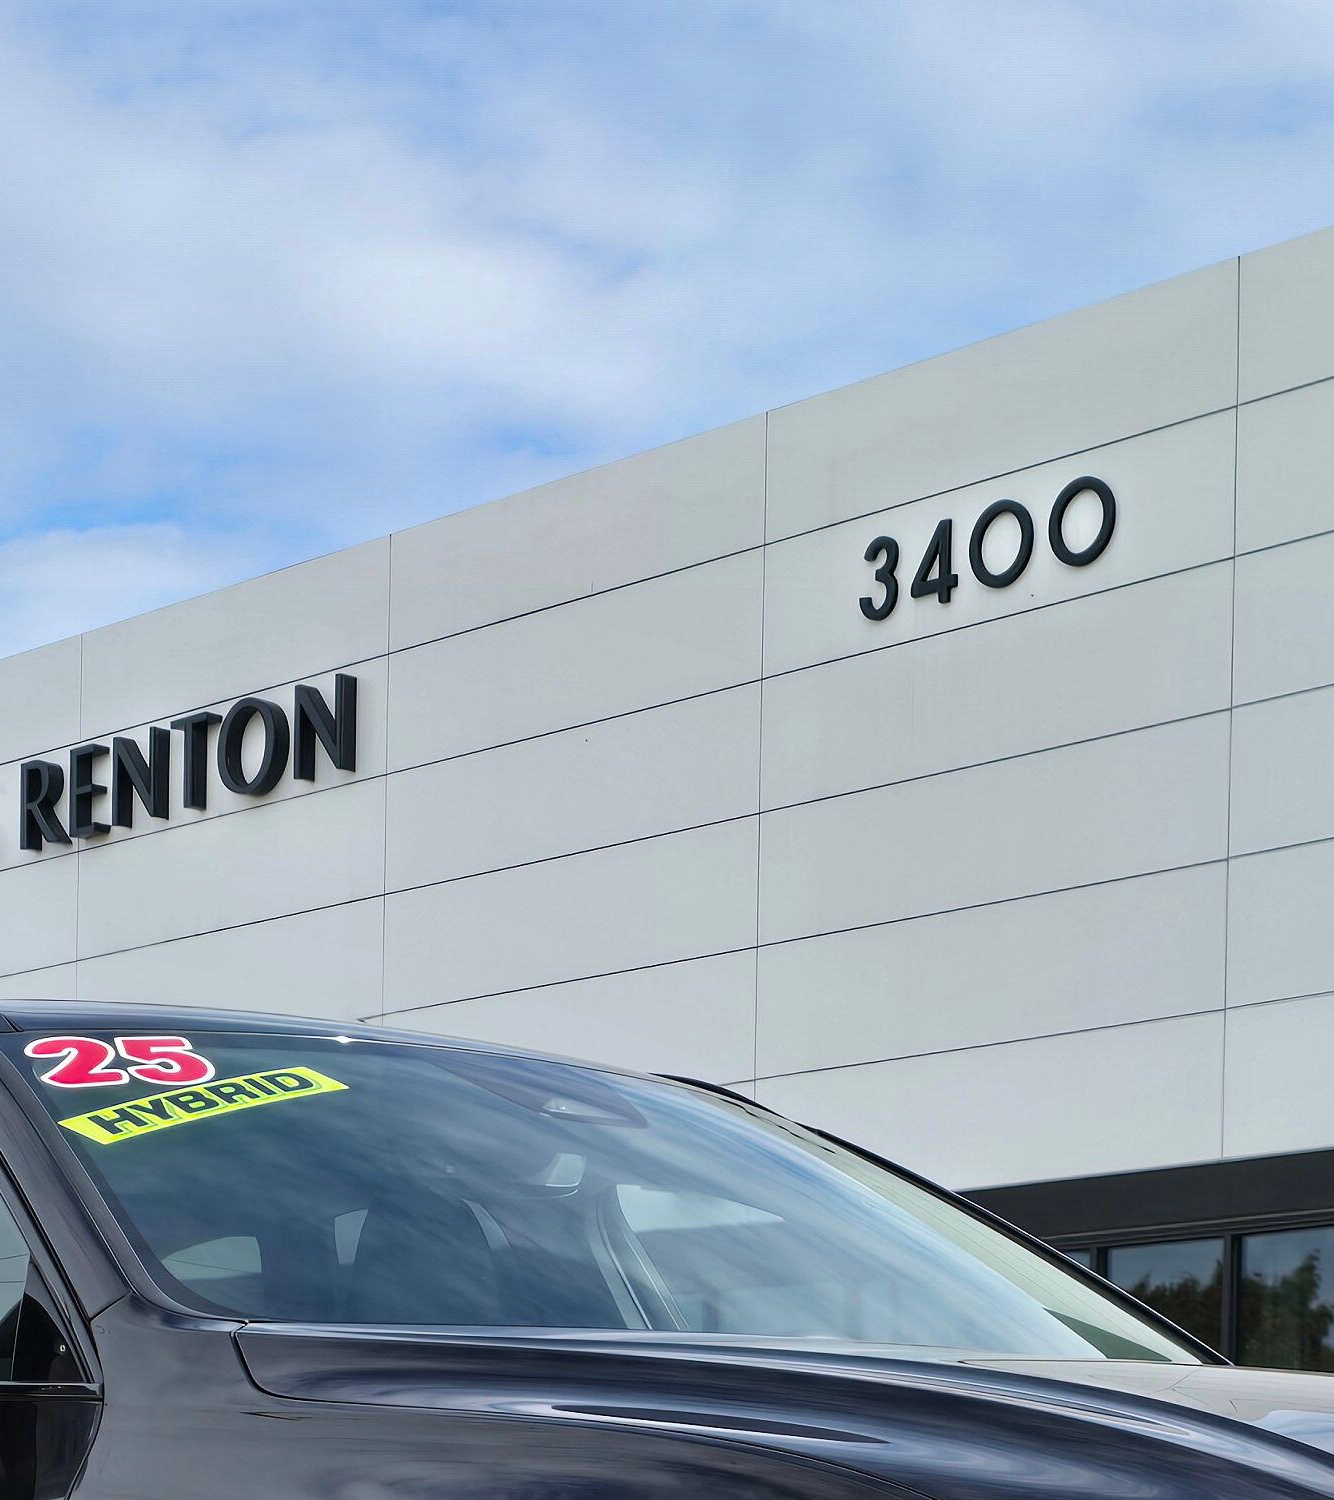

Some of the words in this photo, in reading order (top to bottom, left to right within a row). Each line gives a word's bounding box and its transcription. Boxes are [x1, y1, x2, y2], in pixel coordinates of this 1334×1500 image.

[858, 475, 1117, 622] 3400
[18, 672, 359, 851] RENTON
[23, 1035, 216, 1089] 25
[87, 1071, 320, 1136] HYBRID
